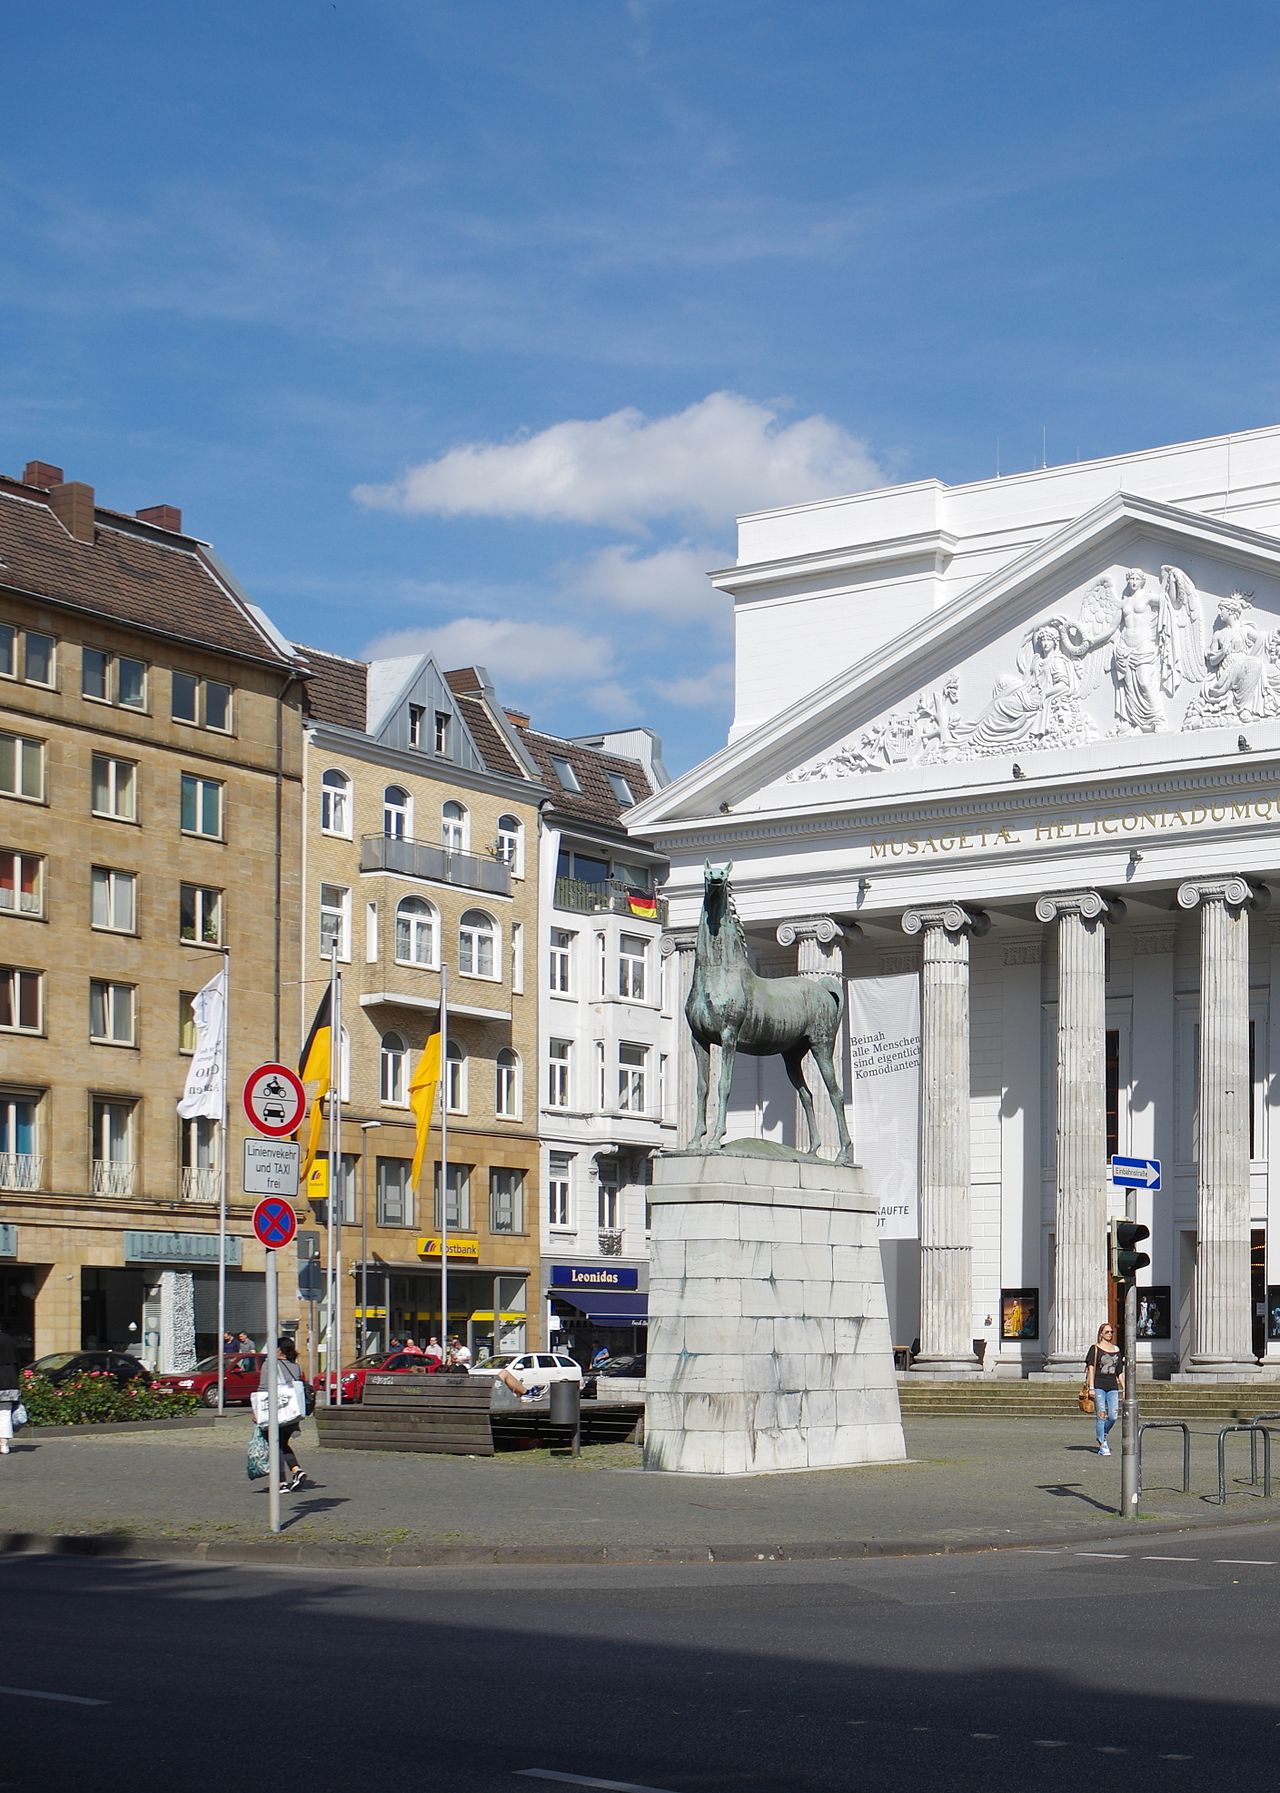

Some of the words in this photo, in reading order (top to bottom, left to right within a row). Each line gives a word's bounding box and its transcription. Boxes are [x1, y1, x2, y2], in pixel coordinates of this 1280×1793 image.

[850, 1031, 886, 1047] Beinah
[852, 1046, 870, 1058] alle
[873, 1035, 920, 1053] Menschen
[853, 1056, 875, 1069] sind
[877, 1045, 922, 1064] eigentlich
[855, 1059, 920, 1080] Komödianten
[255, 1162, 271, 1173] und
[274, 1162, 291, 1175] TAXI
[267, 1176, 281, 1189] frei
[571, 1269, 619, 1284] Leonidas
